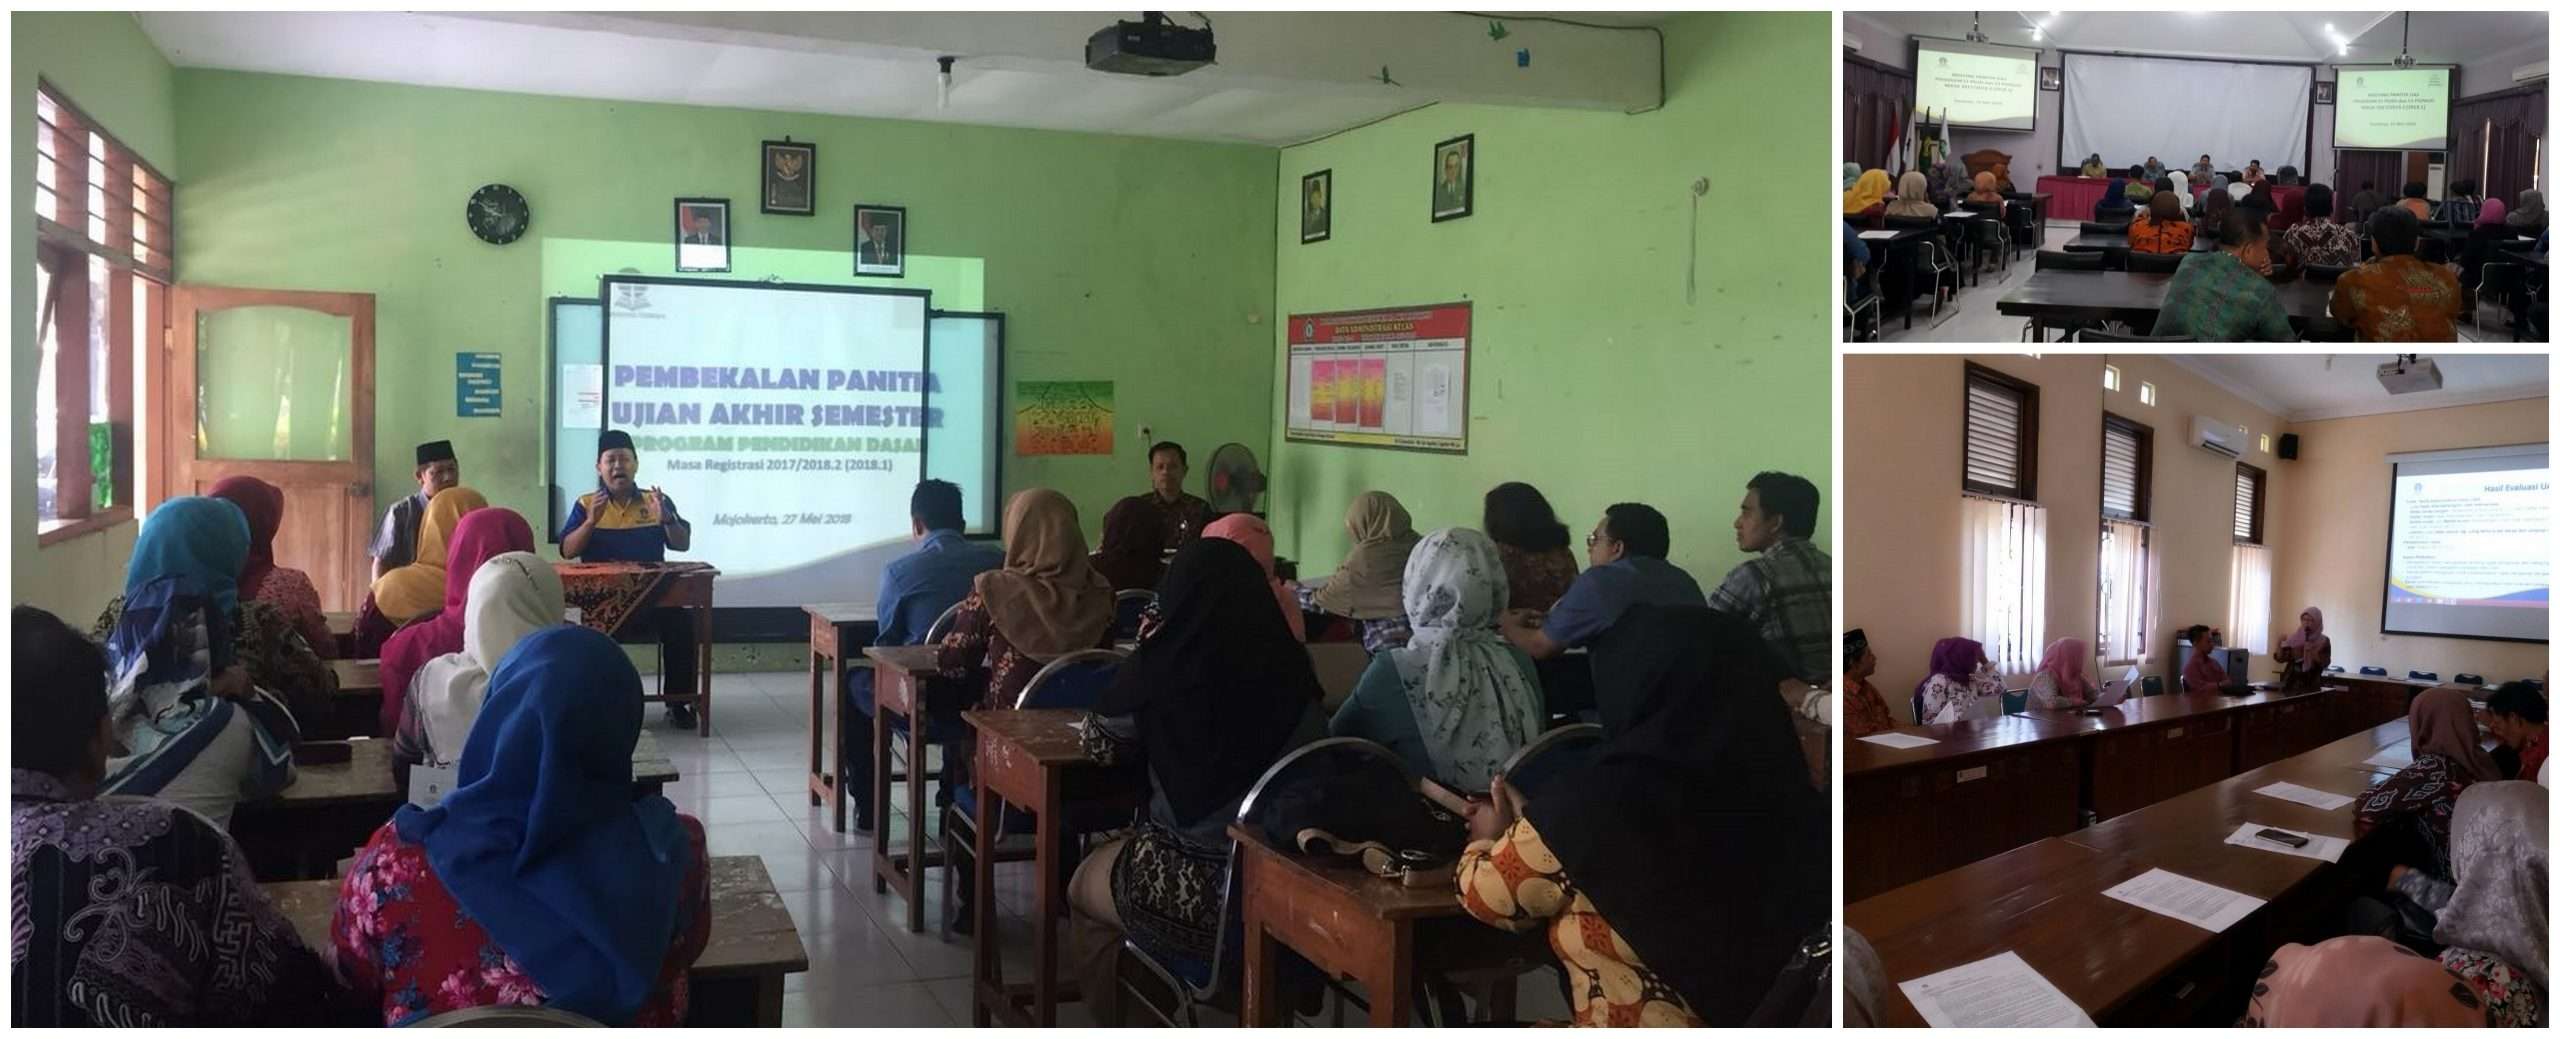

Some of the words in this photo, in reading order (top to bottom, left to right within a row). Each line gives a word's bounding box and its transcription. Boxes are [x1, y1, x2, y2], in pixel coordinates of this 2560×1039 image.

[614, 364, 818, 390] PEMBEKALAN
[826, 369, 942, 393] PANITIA
[611, 401, 701, 427] UJIAN
[709, 402, 804, 426] AKHIR
[810, 404, 945, 428] SEMESTER
[631, 434, 733, 452] PROGRAM
[737, 436, 862, 453] PENDIDIKAN
[667, 458, 702, 471] Masa
[705, 458, 764, 473] Registrasi
[766, 458, 842, 472] 2017/2018.2
[845, 459, 893, 473] (2018.1)
[781, 513, 797, 525] 27
